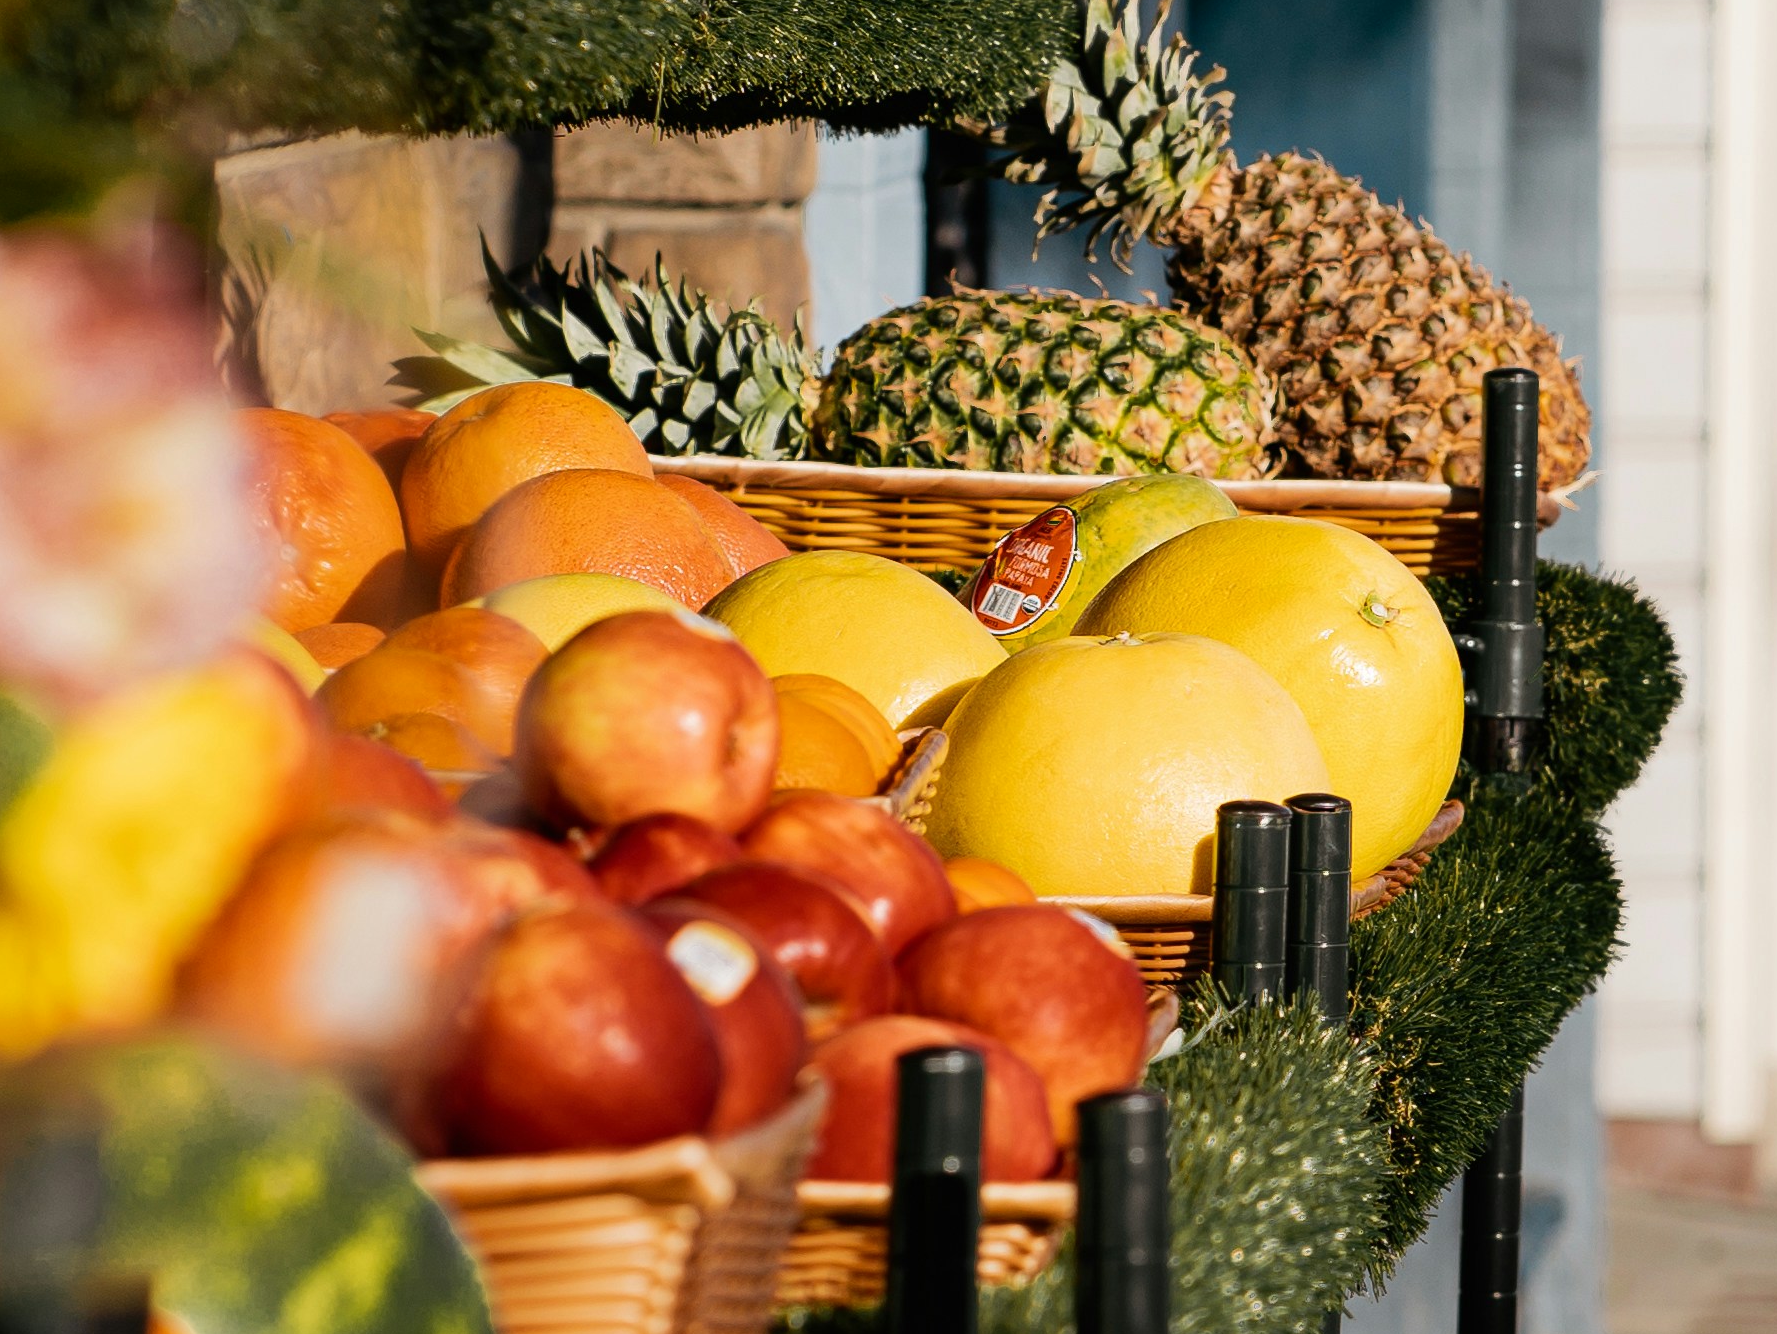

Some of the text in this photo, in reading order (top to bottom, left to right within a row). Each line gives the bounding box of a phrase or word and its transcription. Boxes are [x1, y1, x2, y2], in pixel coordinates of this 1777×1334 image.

[1005, 537, 1055, 564] ORGANIC
[1003, 567, 1035, 587] PAPAYA
[1008, 555, 1051, 580] FORMOSA
